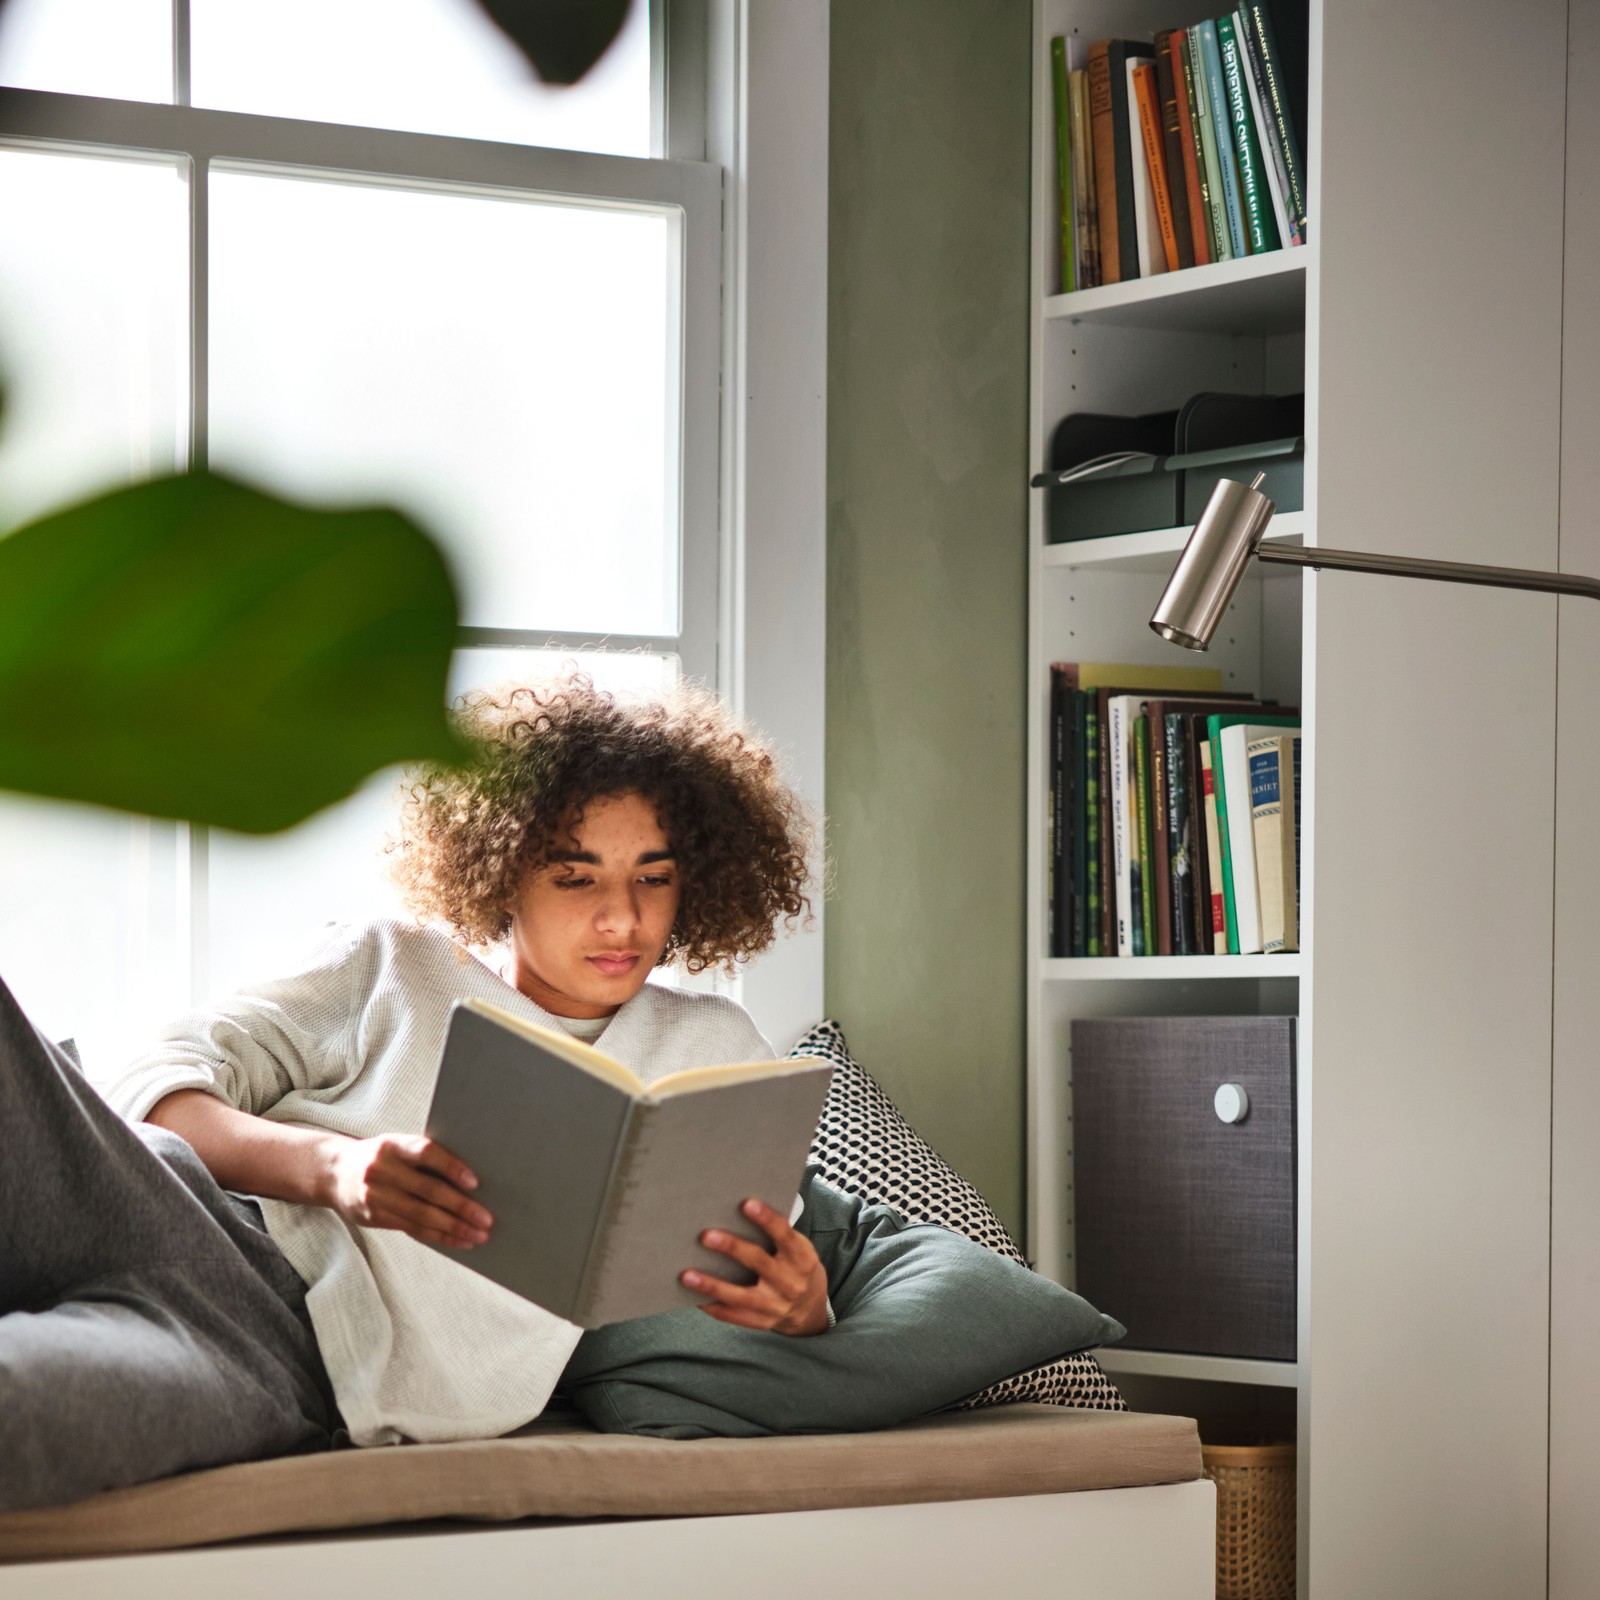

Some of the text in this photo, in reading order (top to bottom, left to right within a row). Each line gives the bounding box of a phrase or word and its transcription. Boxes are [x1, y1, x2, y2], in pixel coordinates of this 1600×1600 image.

[1253, 6, 1269, 61] MARGARET
[1266, 63, 1281, 115] CUTHBERT
[1278, 116, 1287, 138] DEN
[1283, 139, 1294, 172] TYSTA
[1291, 172, 1303, 214] VAGGAN
[1212, 203, 1225, 256] Morocco
[1166, 727, 1175, 770] Survive
[1169, 786, 1178, 806] the
[1170, 807, 1179, 833] Wild
